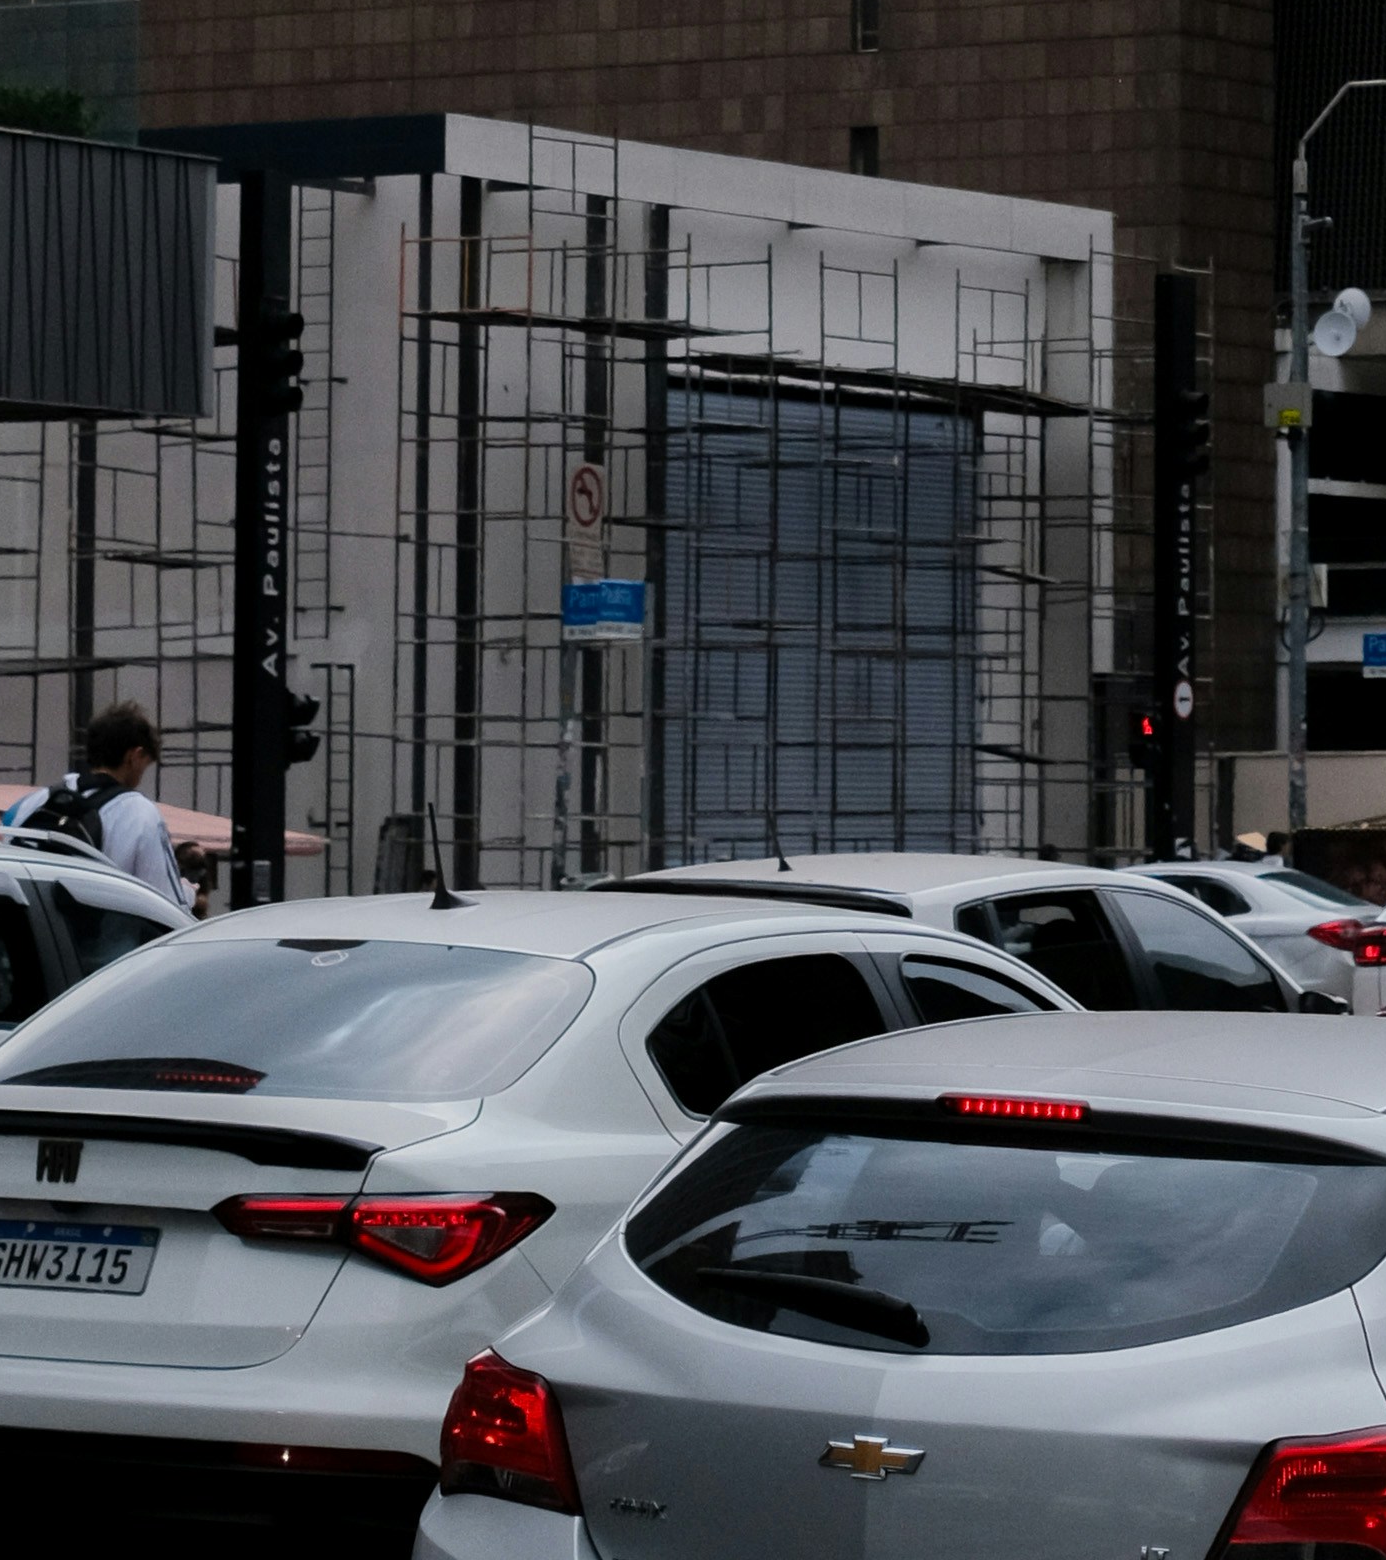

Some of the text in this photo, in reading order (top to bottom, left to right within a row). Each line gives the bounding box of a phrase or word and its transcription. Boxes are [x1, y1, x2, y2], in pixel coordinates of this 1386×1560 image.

[261, 437, 282, 678] Av. Paulista
[1177, 483, 1191, 616] Paulista
